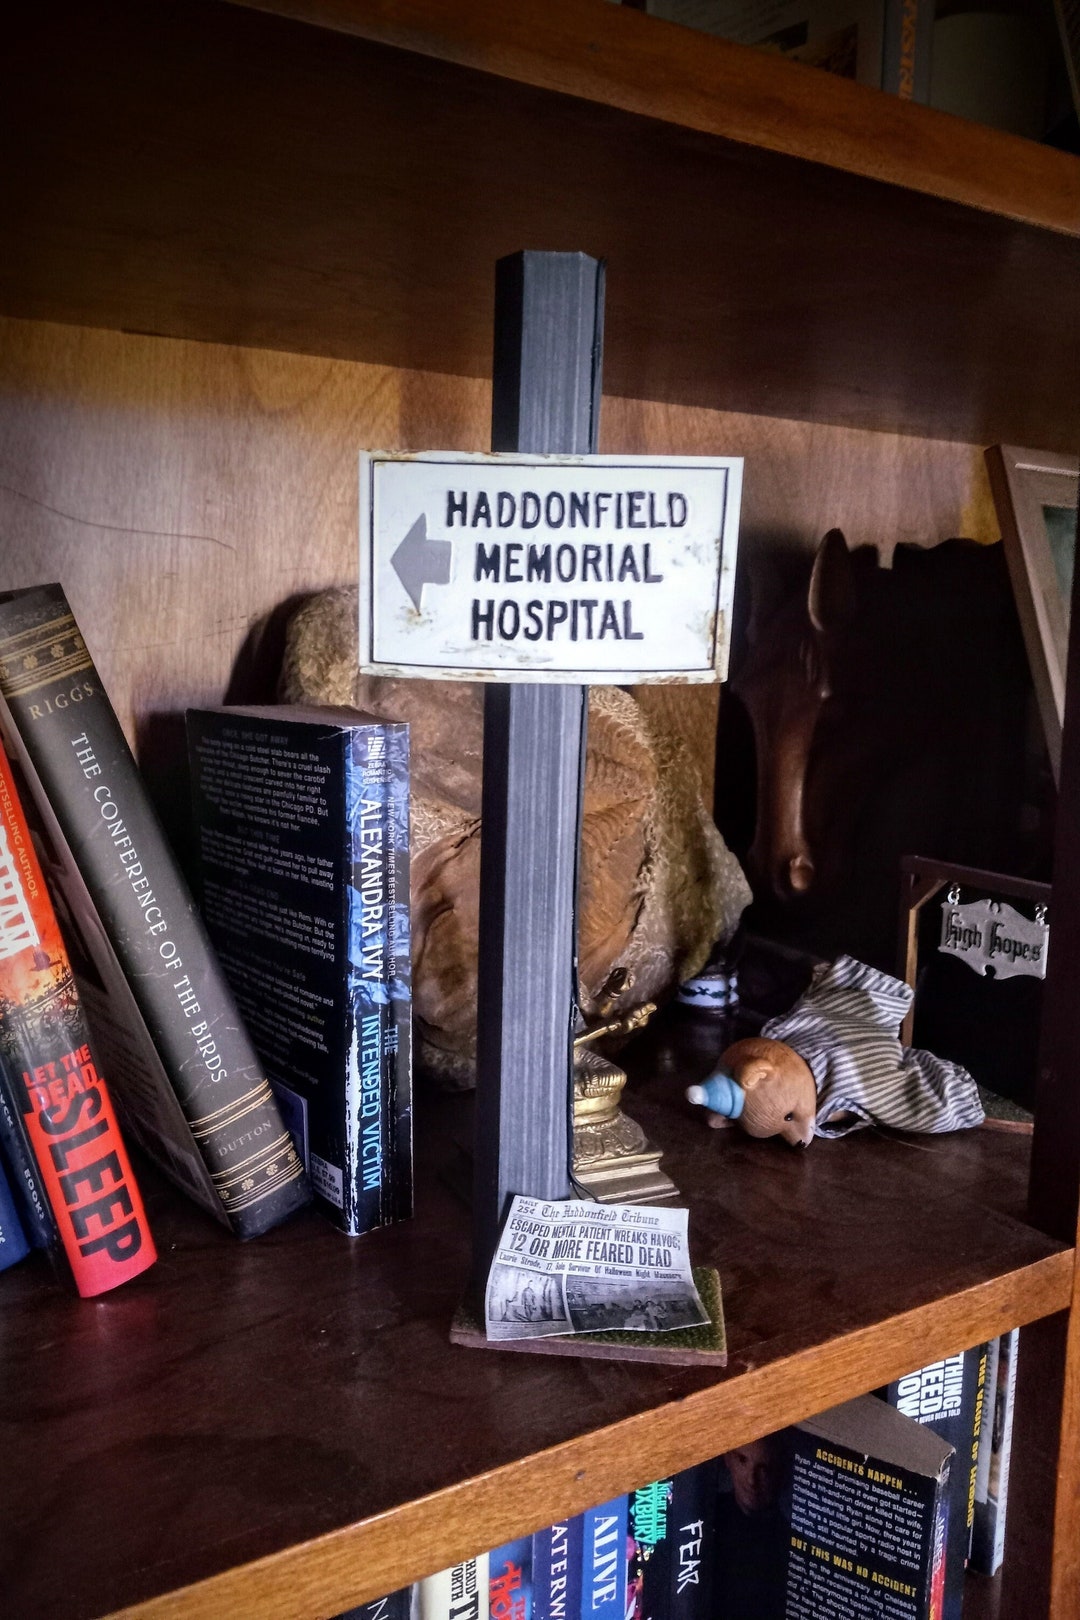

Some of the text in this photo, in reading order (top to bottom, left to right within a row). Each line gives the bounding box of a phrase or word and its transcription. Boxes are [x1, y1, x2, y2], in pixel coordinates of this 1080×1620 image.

[446, 489, 689, 529] HADDONFIELD
[474, 542, 663, 584] MEMORIAL
[471, 599, 644, 641] HOSPITAL
[28, 682, 96, 720] RIGGS
[309, 752, 320, 762] the
[314, 764, 331, 774] slash
[304, 774, 326, 784] carotid
[306, 785, 321, 794] right
[318, 806, 329, 817] But
[320, 797, 327, 806] to
[0, 771, 38, 899] STSELLING AUTHOR
[388, 819, 396, 844] YORK
[317, 857, 334, 868] father
[319, 870, 334, 880] away
[388, 847, 396, 875] TIMES
[360, 798, 383, 979] ALEXANDRA IVY
[71, 732, 228, 1084] THE CONFERENCE OF THE BIRDS
[388, 877, 396, 939] BESTSELLING
[325, 930, 334, 940] the
[328, 942, 334, 950] to
[388, 940, 396, 976] AUTHOR
[323, 998, 334, 1007] and
[384, 1025, 398, 1057] THE
[22, 1043, 92, 1088] LET THE
[27, 1062, 99, 1110] DEAD
[361, 1014, 382, 1192] INTENDED VICTIM
[218, 1119, 273, 1157] DUTTON
[39, 1086, 142, 1263] SLEEP
[516, 1204, 660, 1225] 25¢ The Haddonfield Tribune
[519, 1198, 538, 1208] DAILY
[510, 1218, 551, 1238] ESCAPED
[551, 1224, 578, 1238] MENTAL
[578, 1226, 612, 1241] PATIENT
[614, 1228, 648, 1245] WREAKS
[499, 1252, 518, 1263] Laurie
[604, 1266, 632, 1277] Halloween
[636, 1268, 650, 1278] Night
[508, 1232, 673, 1268] 12 OR MORE FEARED DEAD
[943, 1350, 964, 1411] THING
[978, 1354, 987, 1387] THE
[948, 1408, 961, 1417] TOLD
[973, 1388, 984, 1438] VAULT
[816, 1448, 865, 1476] ACCIDENTS
[971, 1440, 979, 1461] OF
[834, 1480, 856, 1494] before
[862, 1492, 878, 1503] even
[879, 1498, 891, 1509] got
[872, 1484, 901, 1500] baseball
[902, 1496, 925, 1510] career
[656, 1483, 670, 1540] NIGHT AT THE
[846, 1505, 864, 1518] Ryan
[885, 1520, 893, 1530] to
[894, 1526, 910, 1536] care
[912, 1529, 922, 1540] for
[854, 1499, 874, 1512] driver
[875, 1506, 893, 1519] killed
[894, 1512, 905, 1523] his
[906, 1518, 923, 1531] wife,
[817, 1533, 836, 1546] never
[829, 1519, 921, 1561] popular sports radio host in
[831, 1528, 858, 1546] haunted
[859, 1540, 868, 1552] by
[878, 1549, 898, 1562] tragic
[900, 1556, 920, 1570] crime
[883, 1530, 901, 1545] three
[902, 1538, 922, 1550] years
[549, 1518, 569, 1620] ATERW
[592, 1516, 618, 1610] ALIVE
[676, 1519, 704, 1595] FEAR
[790, 1536, 918, 1598] BUT THIS WAS NO ACCIDENT
[466, 1558, 476, 1595] HAUD
[820, 1564, 832, 1575] the
[834, 1572, 871, 1594] anniversary
[873, 1590, 882, 1598] of
